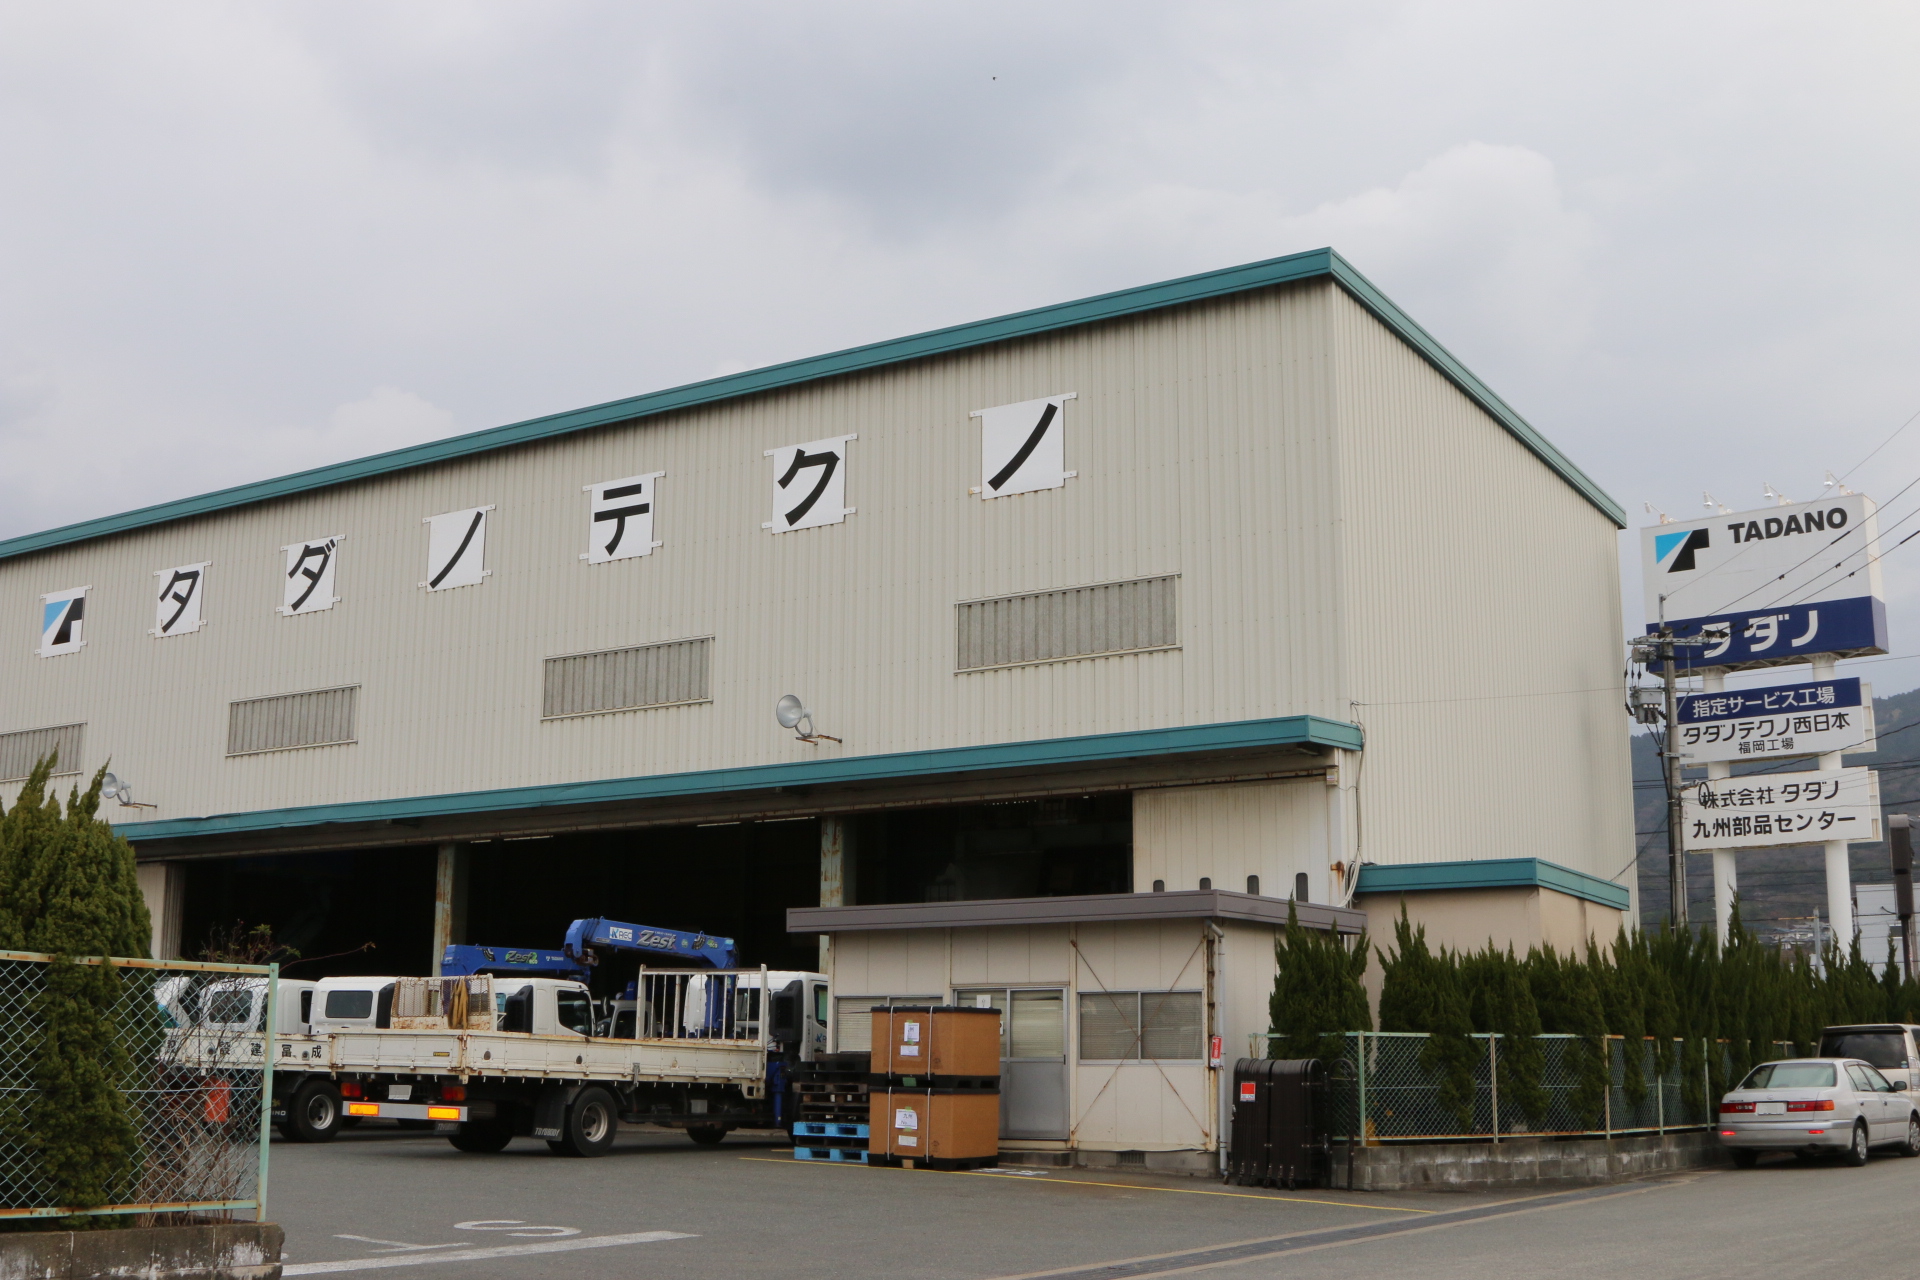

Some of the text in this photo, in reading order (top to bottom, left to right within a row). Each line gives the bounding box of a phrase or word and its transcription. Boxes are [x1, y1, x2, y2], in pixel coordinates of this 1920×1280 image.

[1728, 507, 1848, 544] TADANO
[1701, 610, 1818, 659] タダノ
[1692, 686, 1835, 718] 指定サービス工場
[1683, 712, 1851, 745] タダノテクノ西日本
[1738, 737, 1794, 754] 福岡工場
[1701, 781, 1839, 809] 株式会社 タダノ
[1692, 811, 1856, 838] 九州部品センター
[637, 930, 677, 950] Zest
